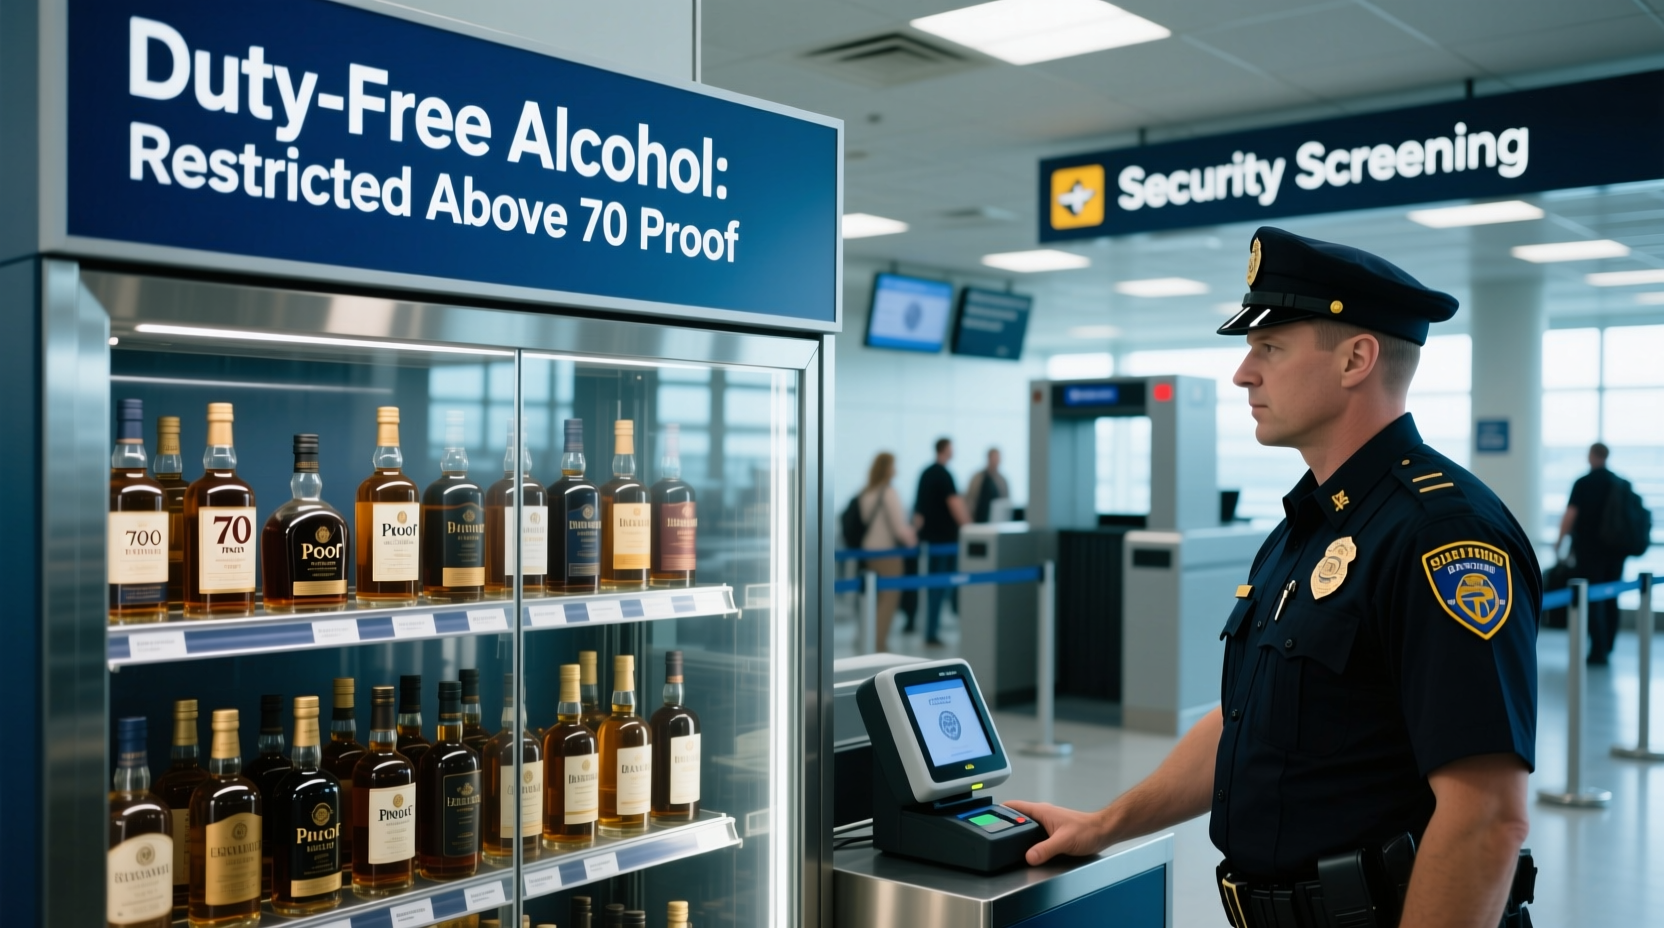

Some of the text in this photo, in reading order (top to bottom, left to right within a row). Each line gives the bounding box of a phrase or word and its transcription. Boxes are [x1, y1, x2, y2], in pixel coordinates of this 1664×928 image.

[129, 16, 729, 200] Duty-Free Alcohol:
[129, 122, 740, 264] Restricted Above 70 Proof
[1118, 121, 1530, 207] Security Screening
[125, 529, 162, 546] 700
[213, 515, 252, 545] 70
